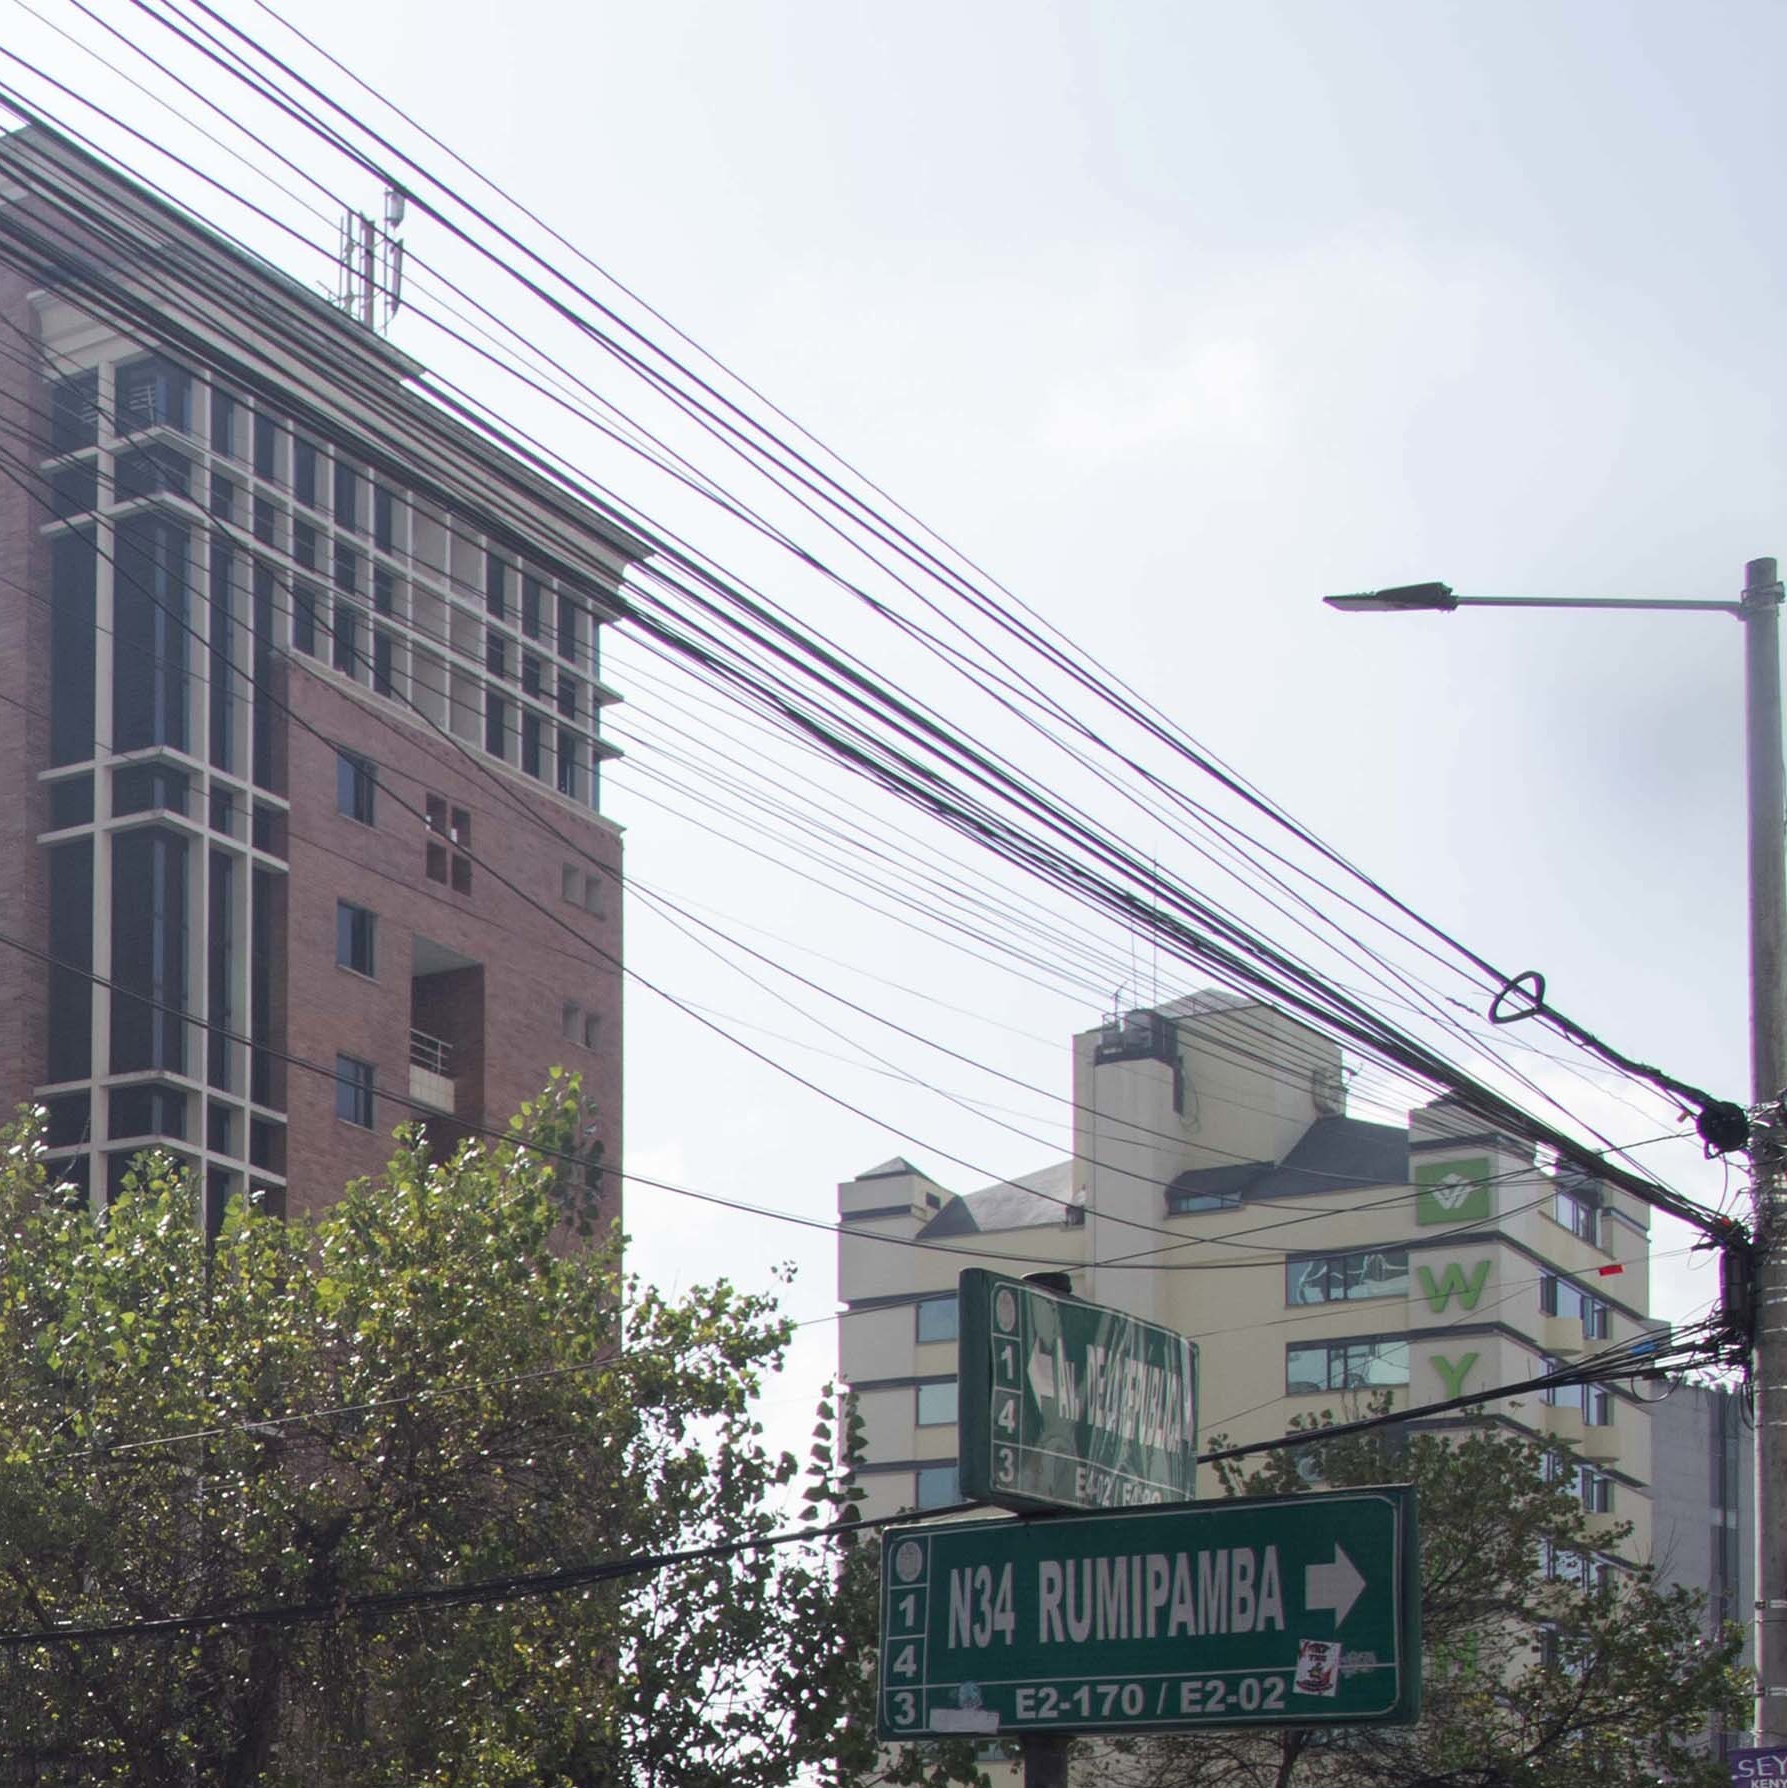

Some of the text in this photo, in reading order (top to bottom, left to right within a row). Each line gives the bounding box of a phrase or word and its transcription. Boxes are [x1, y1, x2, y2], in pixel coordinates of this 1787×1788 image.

[1001, 1345, 1013, 1379] 1
[1086, 1344, 1105, 1428] DE
[998, 1399, 1015, 1434] 4
[998, 1448, 1013, 1482] 3
[899, 1594, 915, 1627] 1
[948, 1545, 1285, 1649] N34 RUMIPAMBA
[893, 1645, 916, 1678] 4
[894, 1692, 915, 1725] 3
[1016, 1684, 1144, 1719] E2-170
[1180, 1677, 1285, 1712] E2-02
